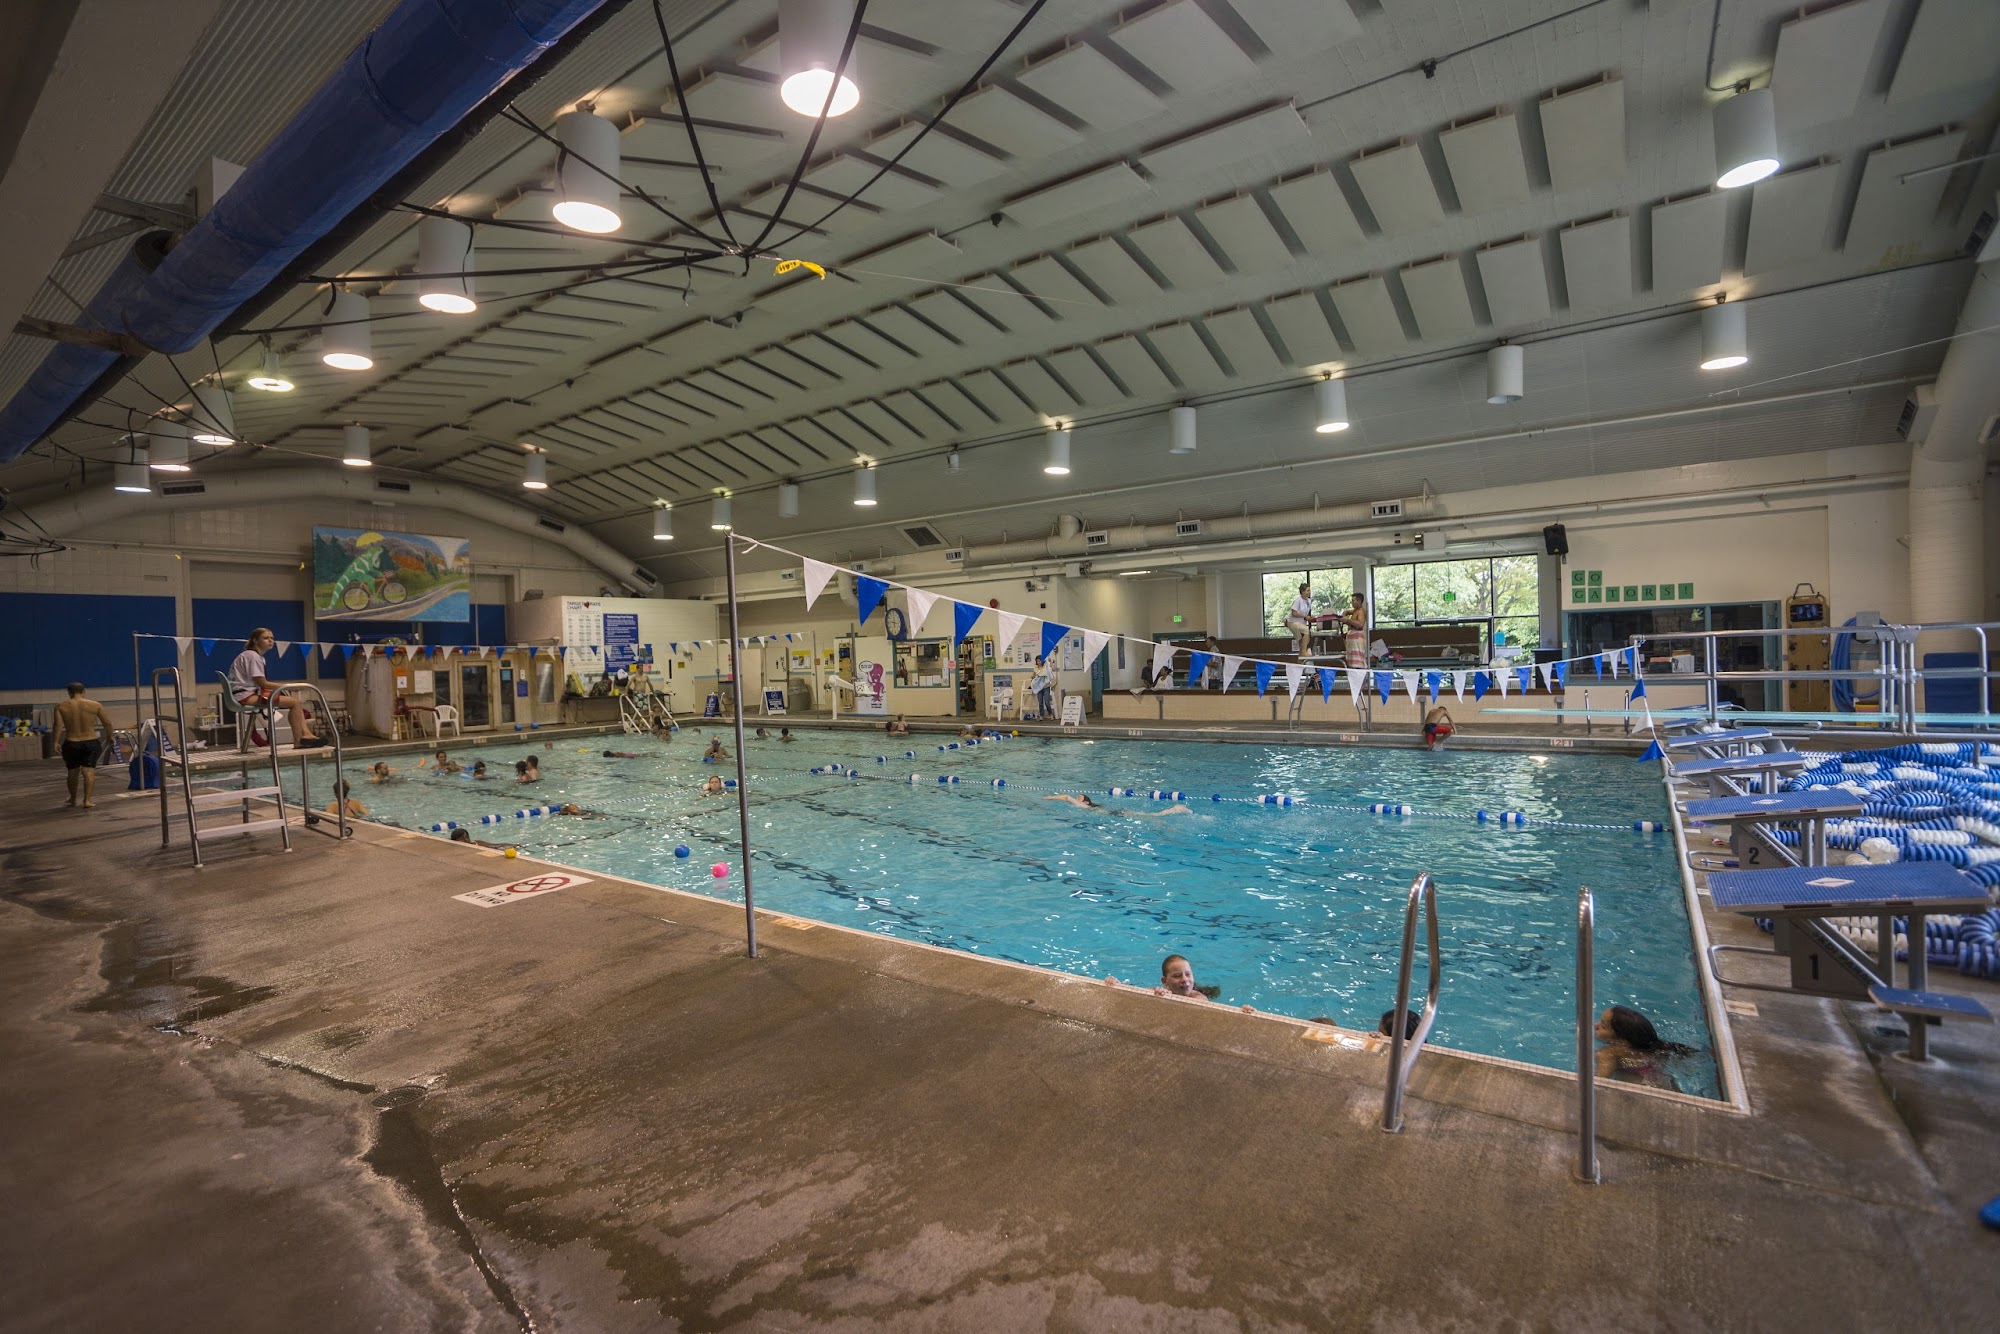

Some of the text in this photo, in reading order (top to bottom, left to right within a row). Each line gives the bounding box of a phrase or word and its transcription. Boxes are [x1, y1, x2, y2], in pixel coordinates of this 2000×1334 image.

[1574, 572, 1600, 582] GO
[1574, 586, 1688, 599] GATORS!
[1748, 846, 1760, 865] 2
[464, 892, 506, 905] DIVING
[1808, 954, 1819, 980] 1
